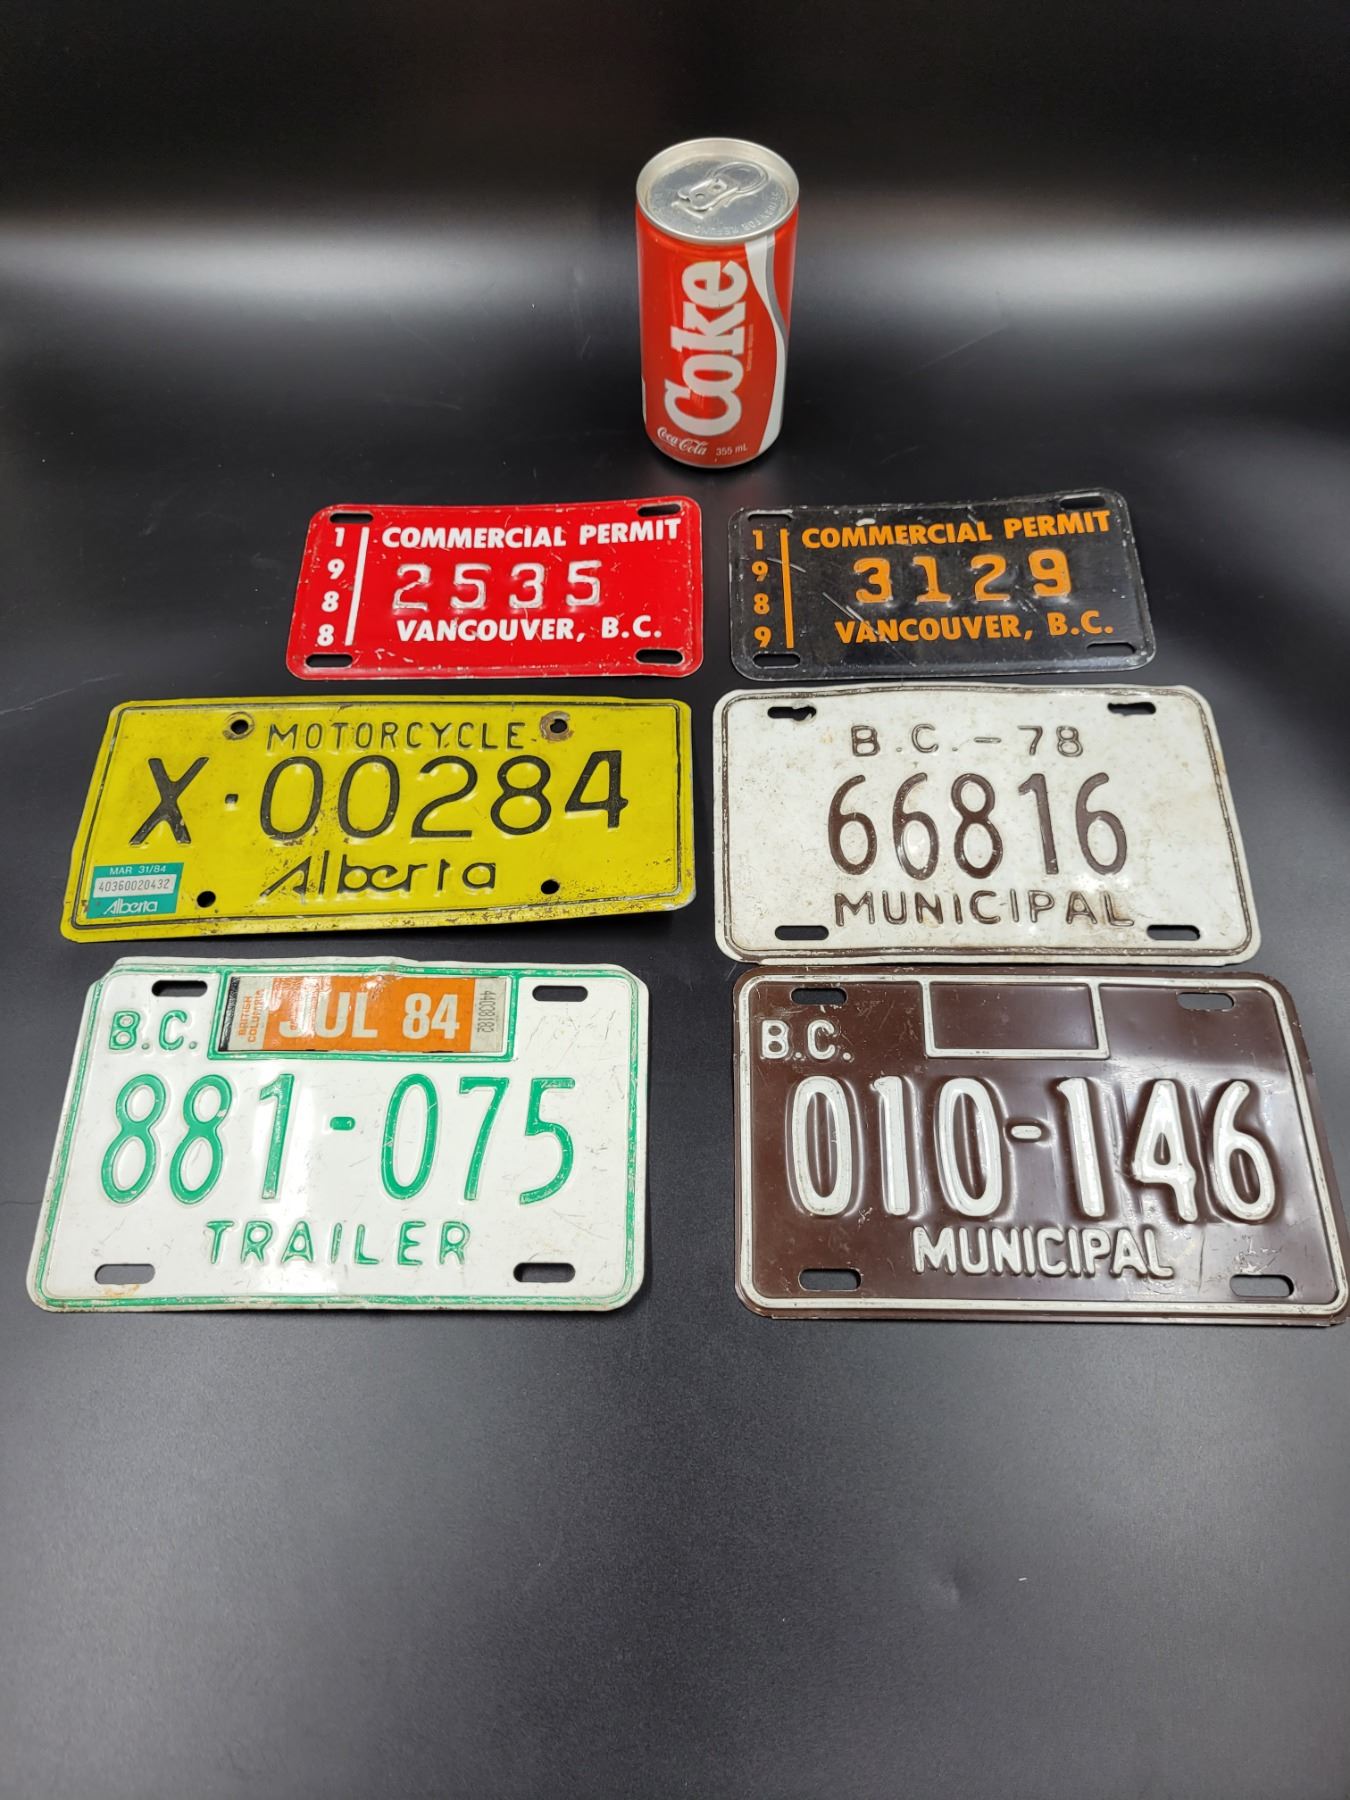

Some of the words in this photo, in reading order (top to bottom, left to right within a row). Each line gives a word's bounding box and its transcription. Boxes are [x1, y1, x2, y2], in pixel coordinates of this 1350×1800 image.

[664, 260, 748, 436] Coke
[715, 446, 733, 456] 355
[381, 526, 567, 549] COMMERCIAL
[578, 518, 682, 545] PERMIT
[801, 522, 993, 549] COMMERCIAL
[1003, 510, 1112, 540] PERMIT
[391, 560, 602, 611] 2535
[853, 548, 1073, 604] 3129
[396, 617, 586, 643] VANCOUVER,
[600, 615, 663, 638] B.C.
[834, 614, 1034, 644] VANCOUVER,
[1047, 610, 1114, 637] B.C.
[267, 721, 527, 752] MOTORCYCLE
[828, 772, 1128, 880] 66816
[109, 866, 132, 875] MAR
[138, 864, 167, 874] 31/84
[259, 850, 496, 898] Alberta
[103, 897, 159, 916] Alberta
[834, 889, 1135, 928] MUNICIPAL
[108, 1009, 199, 1053] B.C.
[277, 990, 379, 1039] JUL
[402, 992, 460, 1040] 84
[760, 1019, 854, 1061] B.C.
[99, 1072, 577, 1206] 881-075
[790, 1075, 1278, 1222] 010-146
[205, 1220, 473, 1267] TRAILER
[912, 1226, 1176, 1279] MUNICIPAL
